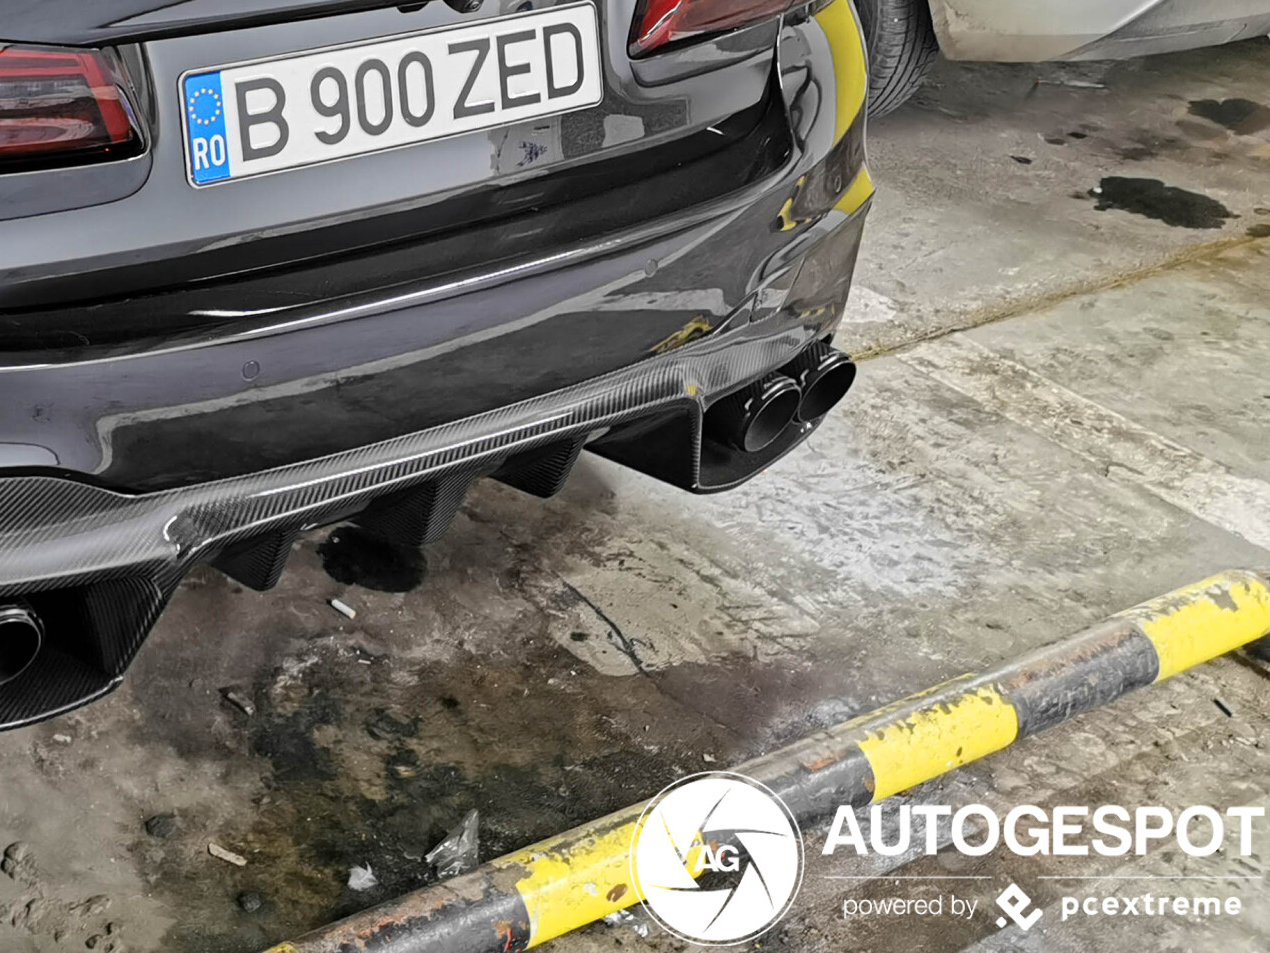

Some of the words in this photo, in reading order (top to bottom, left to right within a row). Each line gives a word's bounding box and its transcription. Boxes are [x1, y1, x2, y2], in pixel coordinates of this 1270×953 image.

[235, 77, 289, 162] B
[310, 51, 435, 145] 900
[447, 22, 584, 120] ZED
[192, 134, 226, 170] RO
